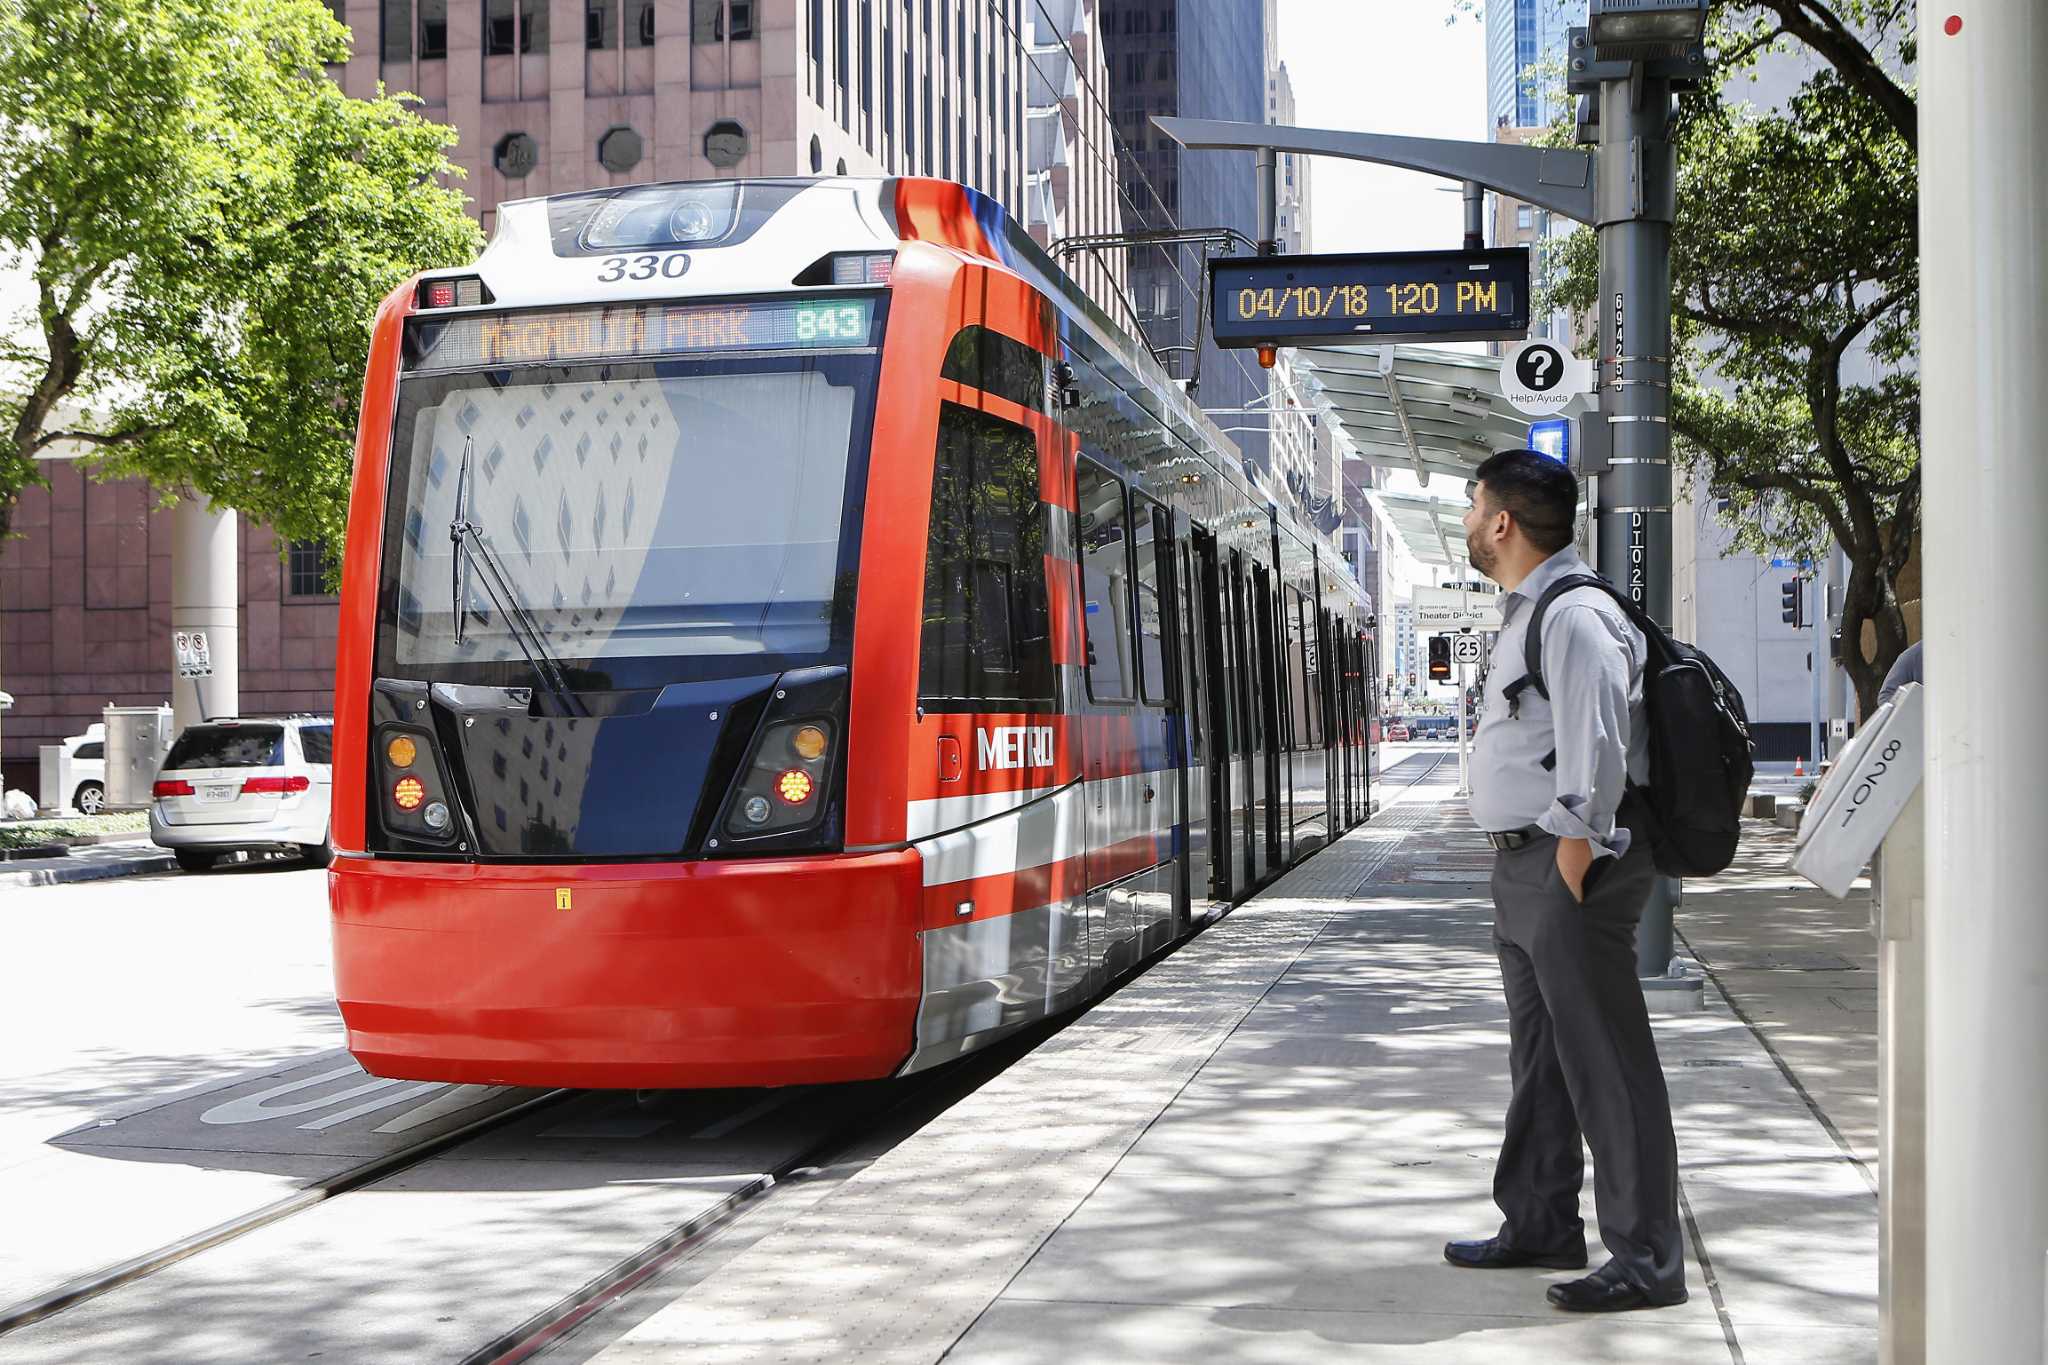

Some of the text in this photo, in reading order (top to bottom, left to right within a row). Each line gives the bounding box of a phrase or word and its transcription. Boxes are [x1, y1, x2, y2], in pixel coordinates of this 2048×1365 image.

[597, 253, 692, 283] 330
[1239, 280, 1497, 320] 04/10/18 1:20 PM
[665, 309, 751, 348] PARK
[796, 307, 860, 339] 843
[1510, 394, 1569, 404] Help/Ayuda
[1459, 642, 1478, 656] 25
[976, 726, 1054, 771] METRO
[1842, 739, 1901, 828] 1028
